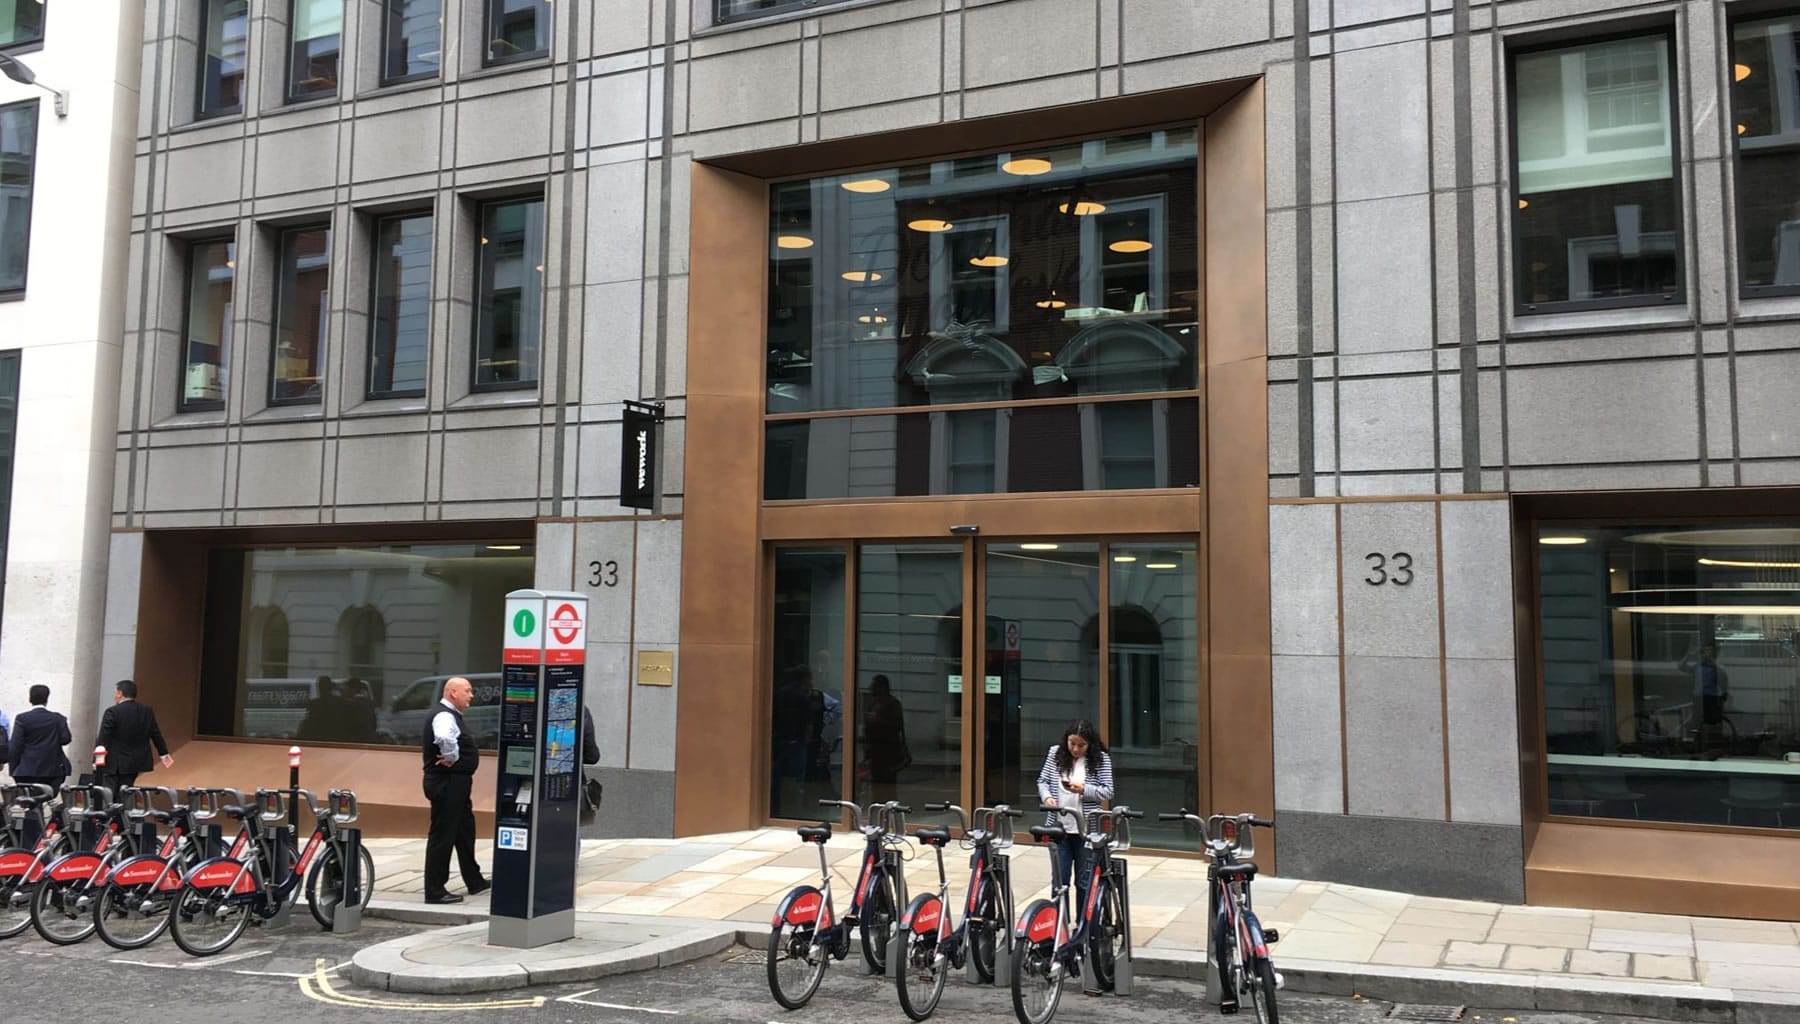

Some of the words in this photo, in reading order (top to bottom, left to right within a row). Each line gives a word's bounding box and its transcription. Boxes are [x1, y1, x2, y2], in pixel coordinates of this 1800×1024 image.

[637, 430, 647, 489] wework
[588, 560, 618, 587] 33
[1365, 552, 1414, 586] 33
[129, 868, 157, 877] Santander
[206, 870, 233, 879] Santander
